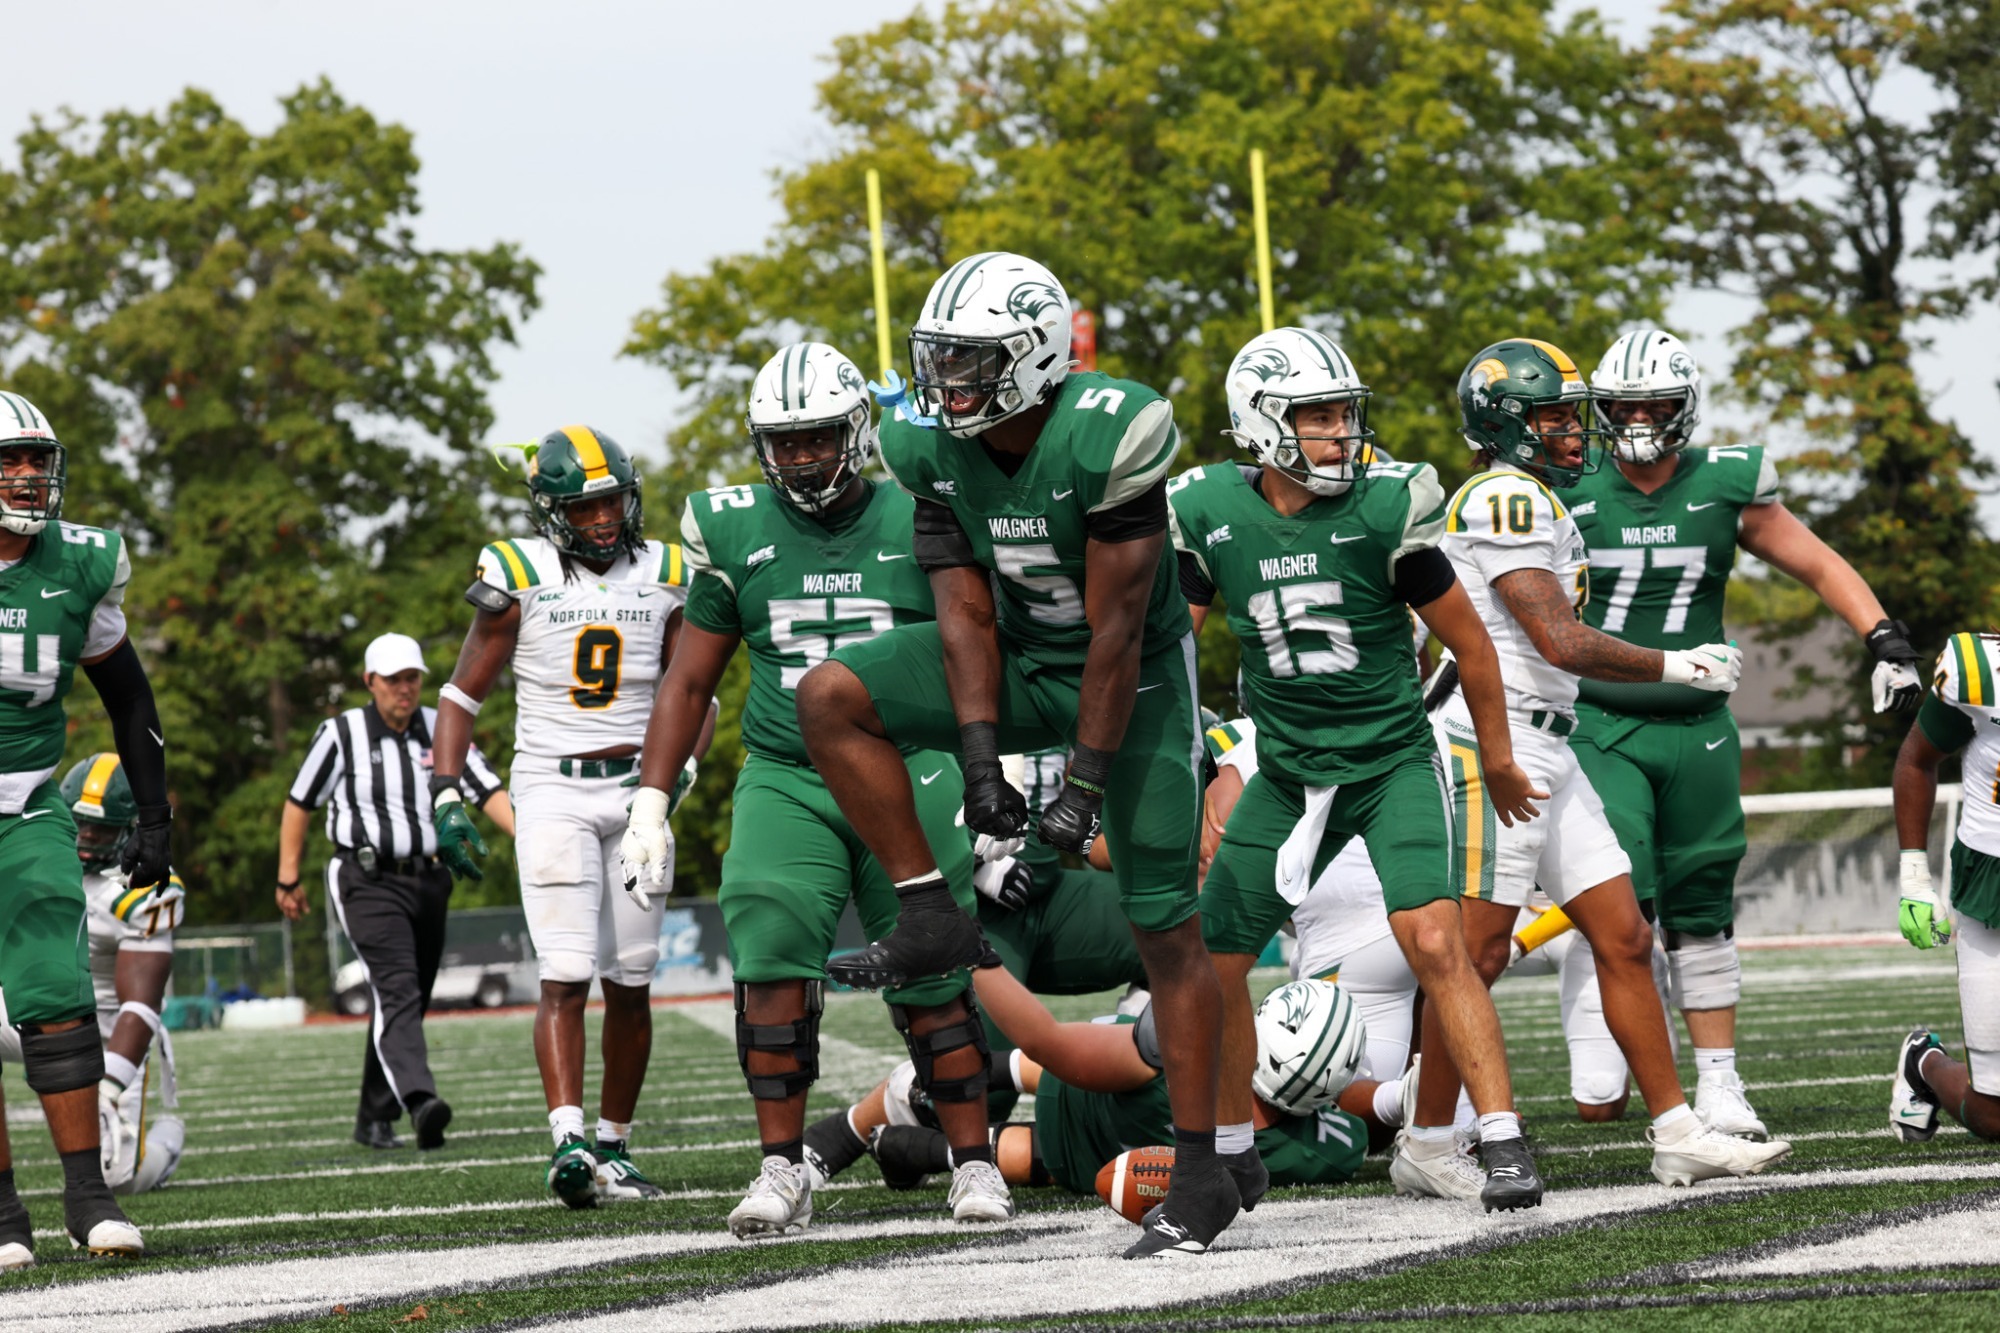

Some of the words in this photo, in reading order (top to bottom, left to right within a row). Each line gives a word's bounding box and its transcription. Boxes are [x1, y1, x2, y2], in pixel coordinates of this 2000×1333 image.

[1074, 387, 1126, 415] 5
[988, 517, 1049, 539] WAGNER
[1487, 494, 1534, 535] 10
[1622, 524, 1676, 545] WAGNER
[803, 573, 862, 594] WAGNER
[993, 544, 1085, 624] 5
[1259, 553, 1318, 581] WAGNER
[1588, 546, 1707, 634] 77
[549, 609, 608, 623] NORFOLK
[616, 610, 651, 622] STATE
[1248, 581, 1360, 678] 15
[569, 624, 623, 710] 9
[143, 897, 178, 938] 77
